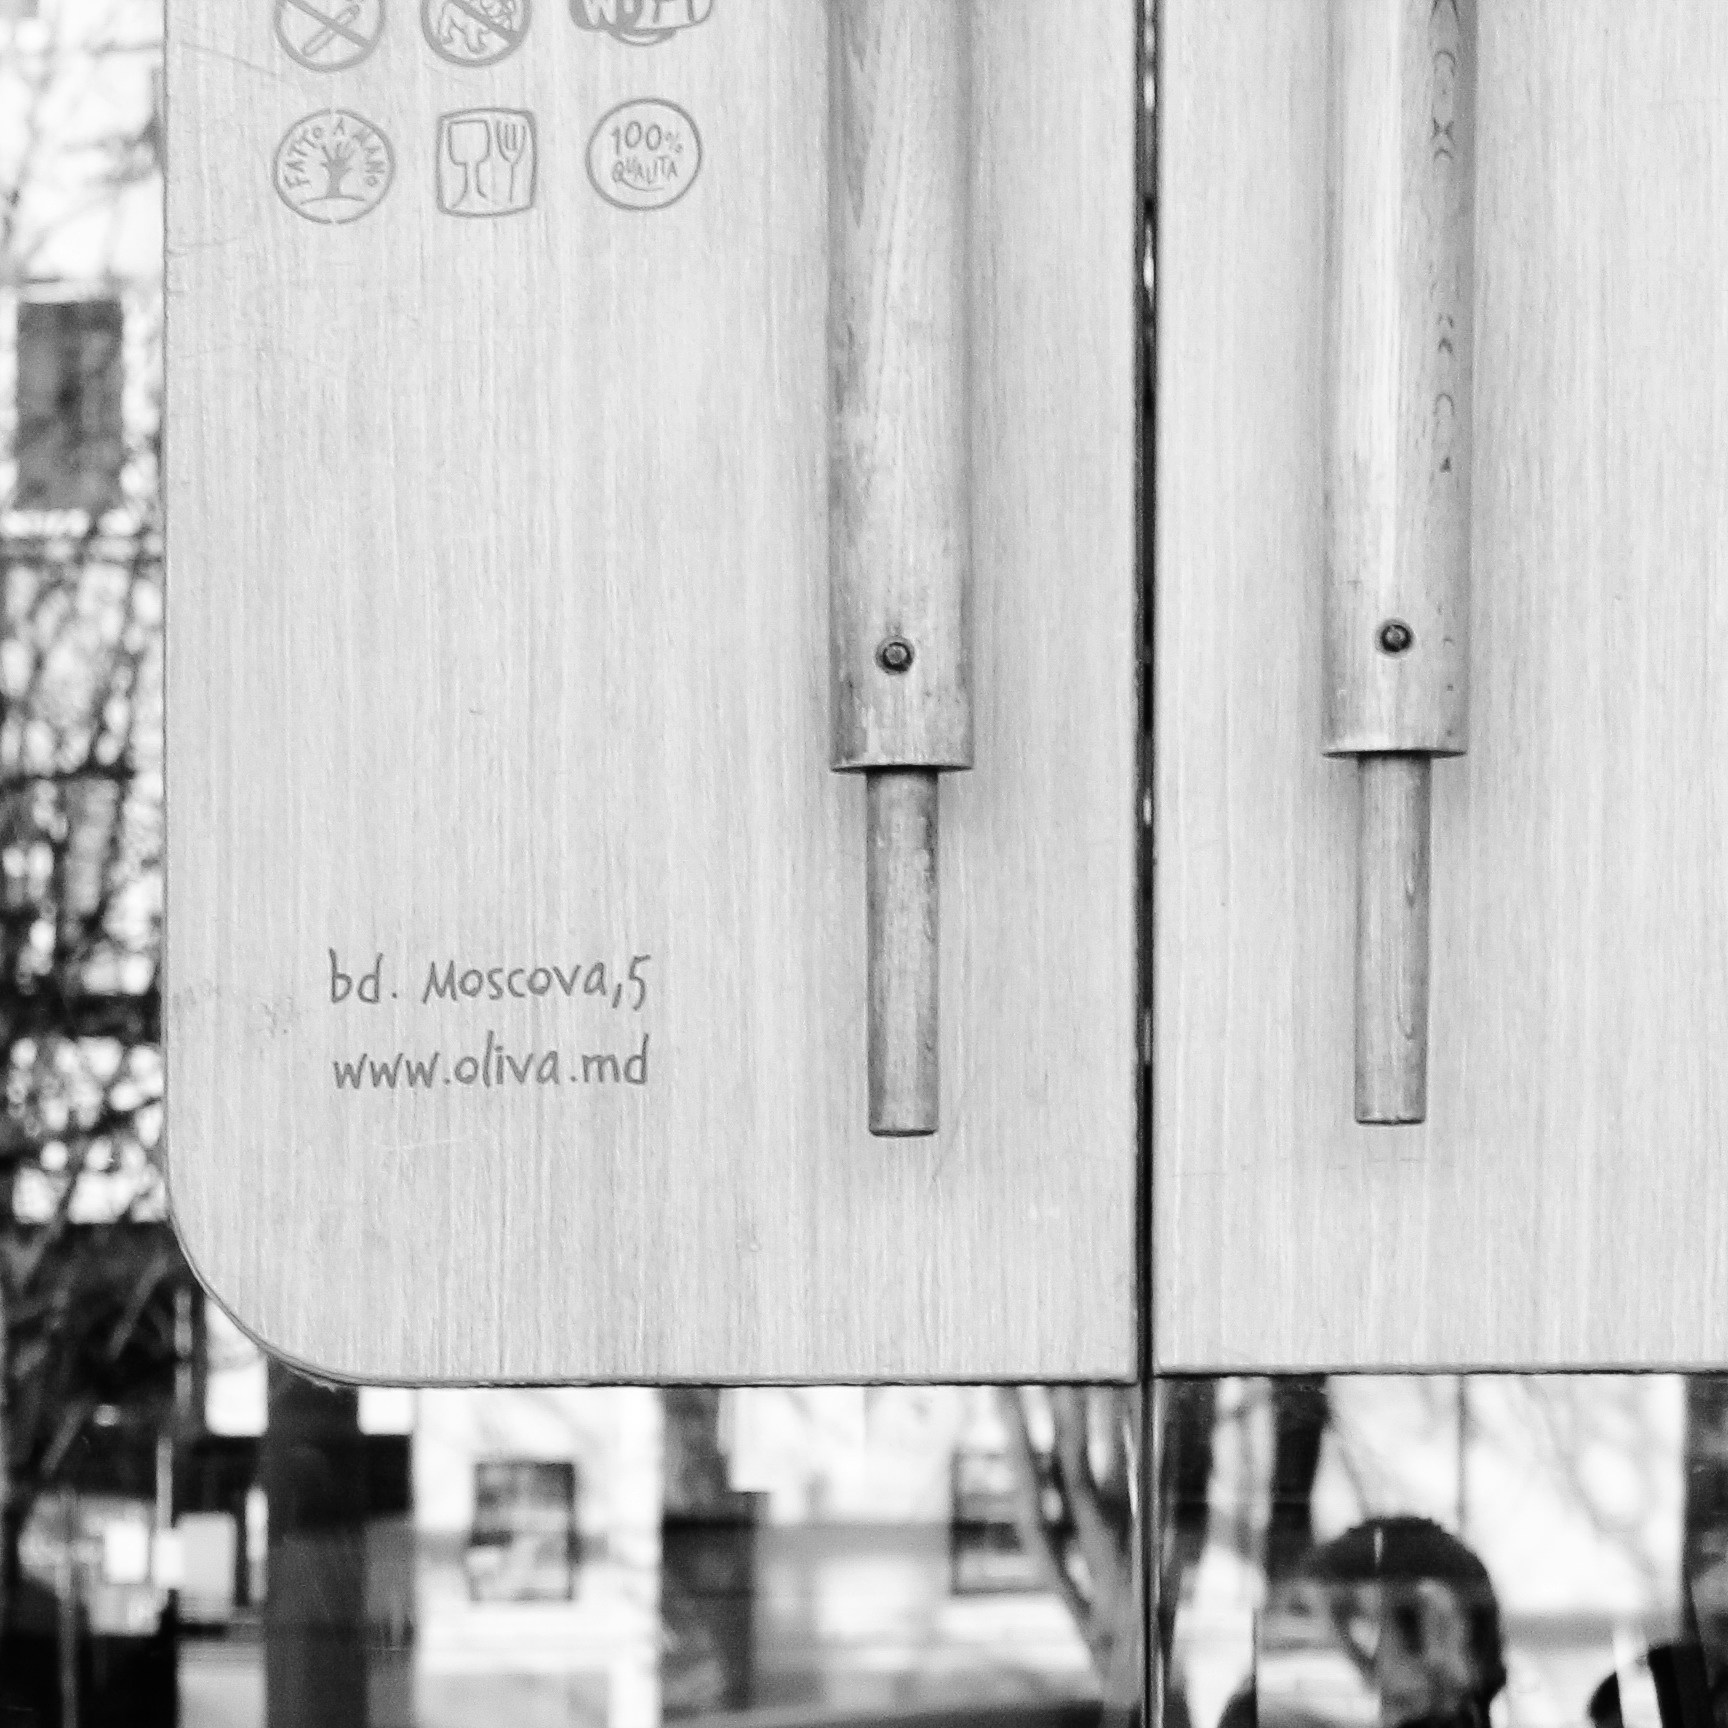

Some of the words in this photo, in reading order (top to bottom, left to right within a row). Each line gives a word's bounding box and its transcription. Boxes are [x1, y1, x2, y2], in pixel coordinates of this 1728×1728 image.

[611, 121, 684, 155] 100%
[329, 947, 397, 1003] bd.
[332, 1029, 649, 1088] www.oliva.md
